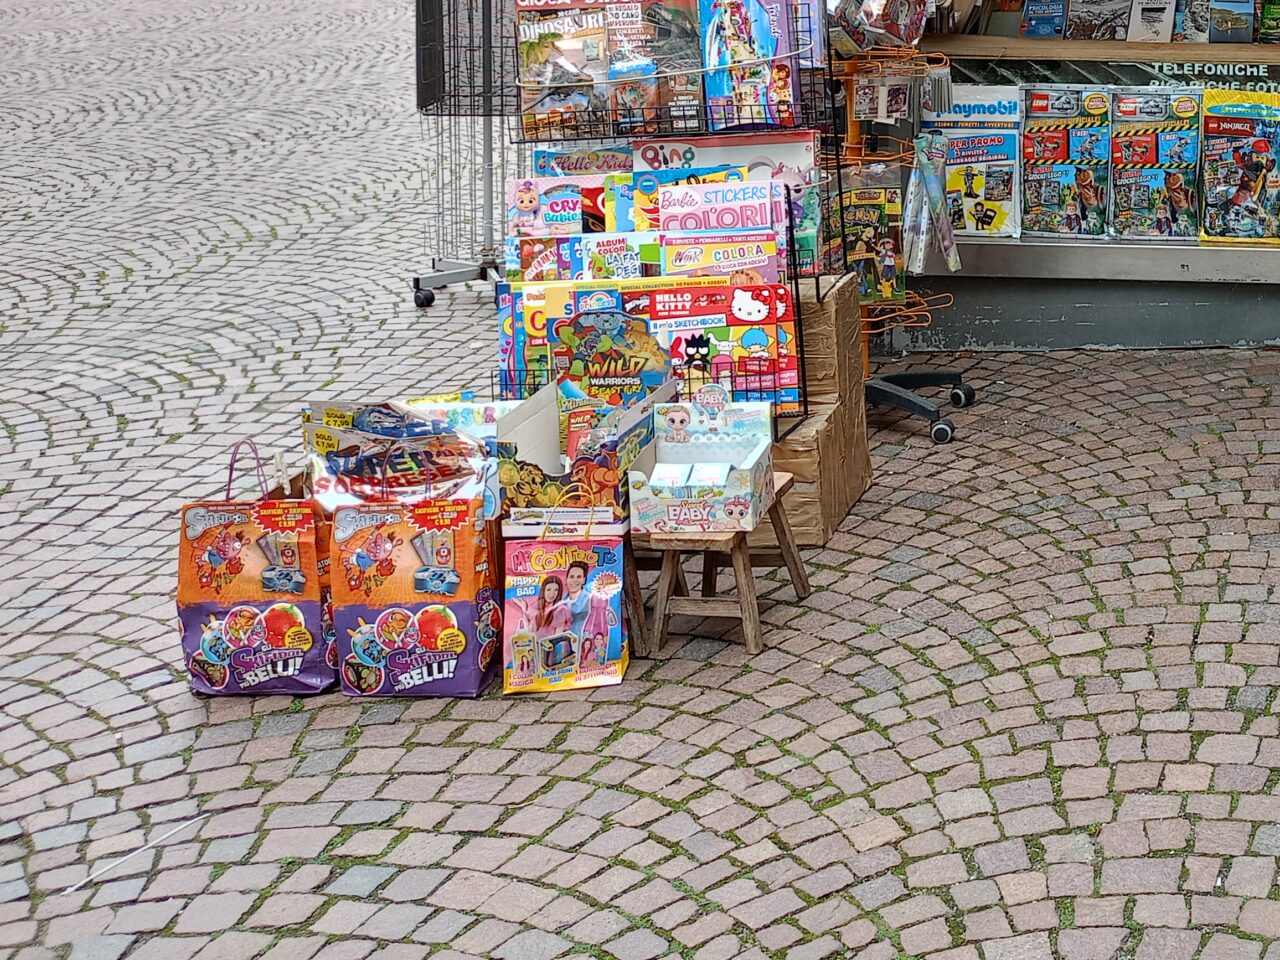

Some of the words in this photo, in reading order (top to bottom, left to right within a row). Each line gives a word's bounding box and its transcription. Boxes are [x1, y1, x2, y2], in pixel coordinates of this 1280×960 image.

[519, 12, 604, 40] DINOSAURI
[1151, 62, 1269, 77] TELEFONICHE
[936, 100, 1018, 118] aymobil
[1032, 99, 1048, 107] LEGO
[1219, 122, 1251, 131] NINJAGO
[970, 136, 1003, 147] PROMO
[551, 154, 592, 172] Hello
[641, 144, 696, 170] Bing
[661, 190, 699, 210] Barbie
[704, 187, 767, 204] STICKERS
[549, 199, 579, 213] CRY
[596, 238, 626, 249] ALBUM
[713, 244, 764, 262] COLORA
[748, 258, 768, 266] ADESIVI
[655, 293, 692, 302] HELLO
[656, 301, 692, 311] KITTY
[674, 317, 725, 329] SKETCHBOOK
[588, 356, 648, 377] WILD
[590, 377, 641, 385] WARRIORS
[590, 386, 624, 396] BEAST
[696, 393, 725, 403] BABY
[668, 507, 711, 521] BABY
[510, 576, 540, 586] HAPPY
[516, 587, 536, 596] BAG
[243, 657, 304, 687] BELLI!
[398, 659, 458, 690] BELLI!
